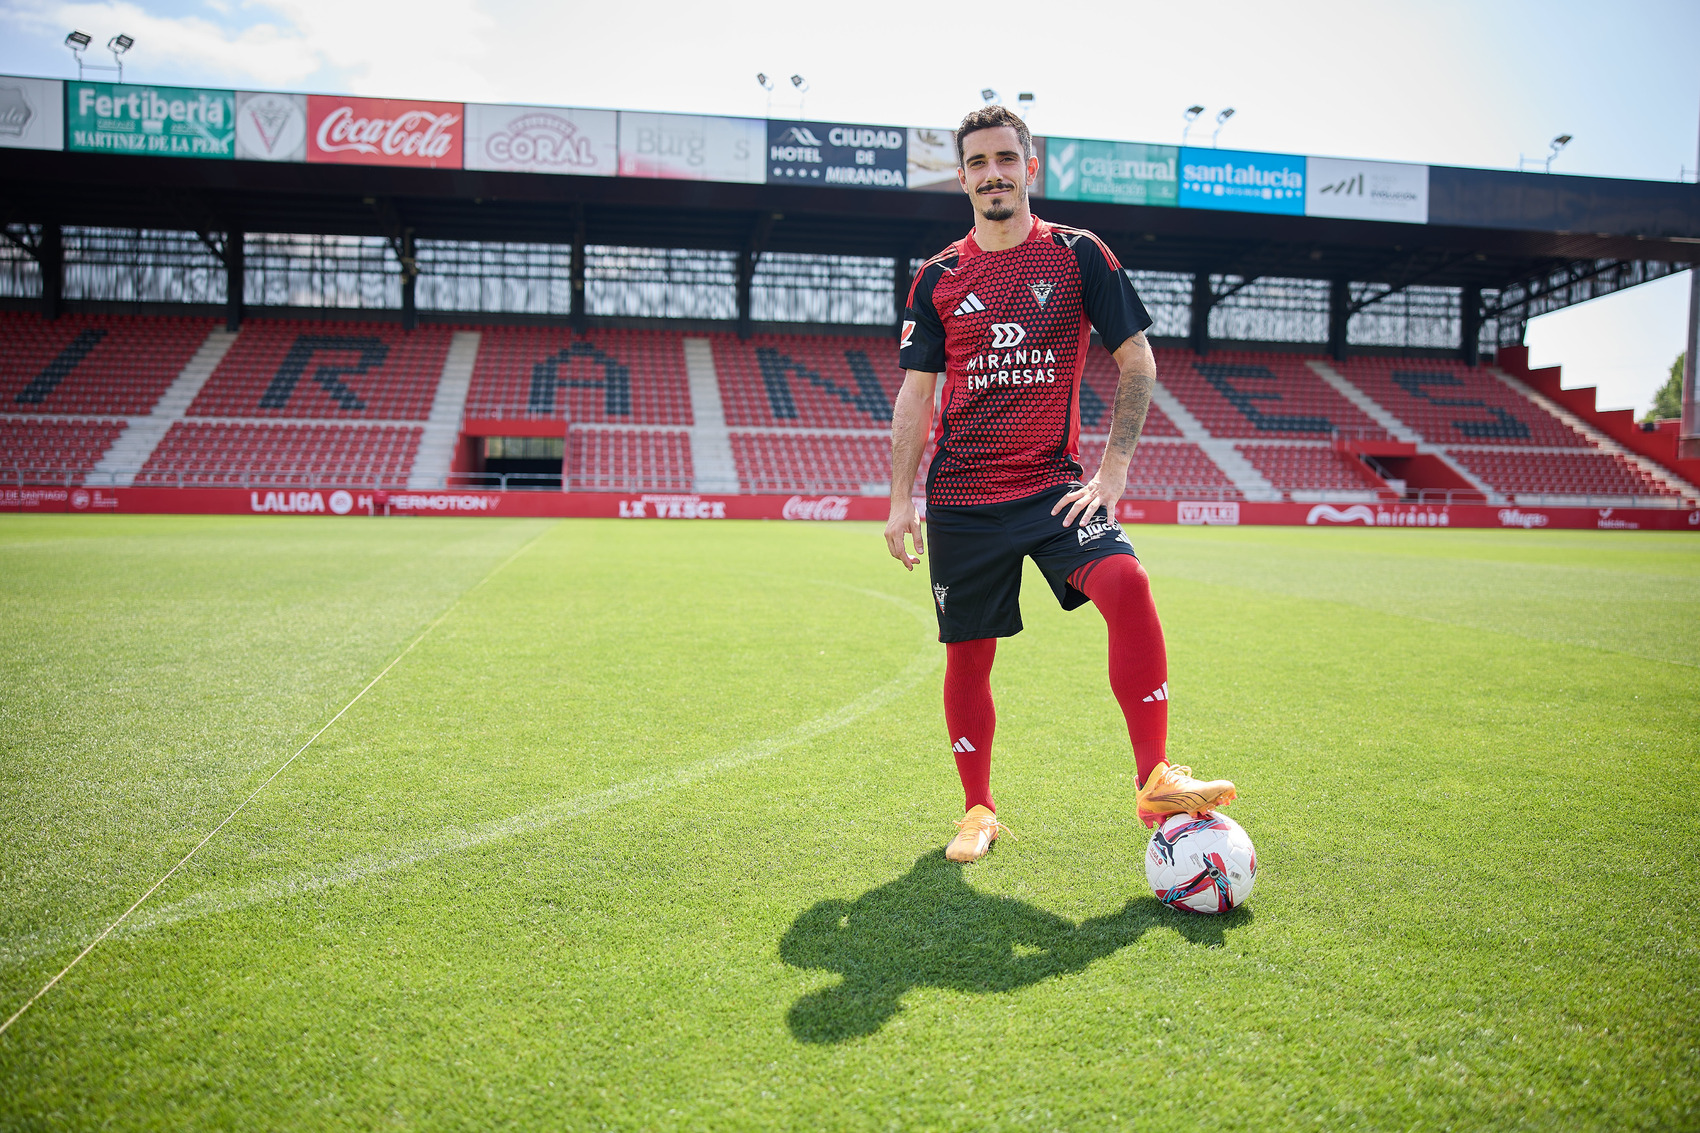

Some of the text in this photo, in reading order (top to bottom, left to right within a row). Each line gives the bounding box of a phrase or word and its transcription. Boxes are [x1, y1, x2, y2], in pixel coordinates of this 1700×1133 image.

[79, 88, 224, 124] Fertiberia
[148, 135, 169, 151] DE
[172, 137, 190, 153] LA
[828, 128, 903, 149] CIUDAD
[486, 132, 598, 167] CORAL
[771, 146, 823, 163] HOTEL
[856, 150, 876, 165] DE
[825, 167, 905, 186] MIRANDA
[966, 349, 1056, 371] MIRANDA
[967, 369, 1056, 390] EMPRESAS
[251, 492, 325, 512] LALIGA
